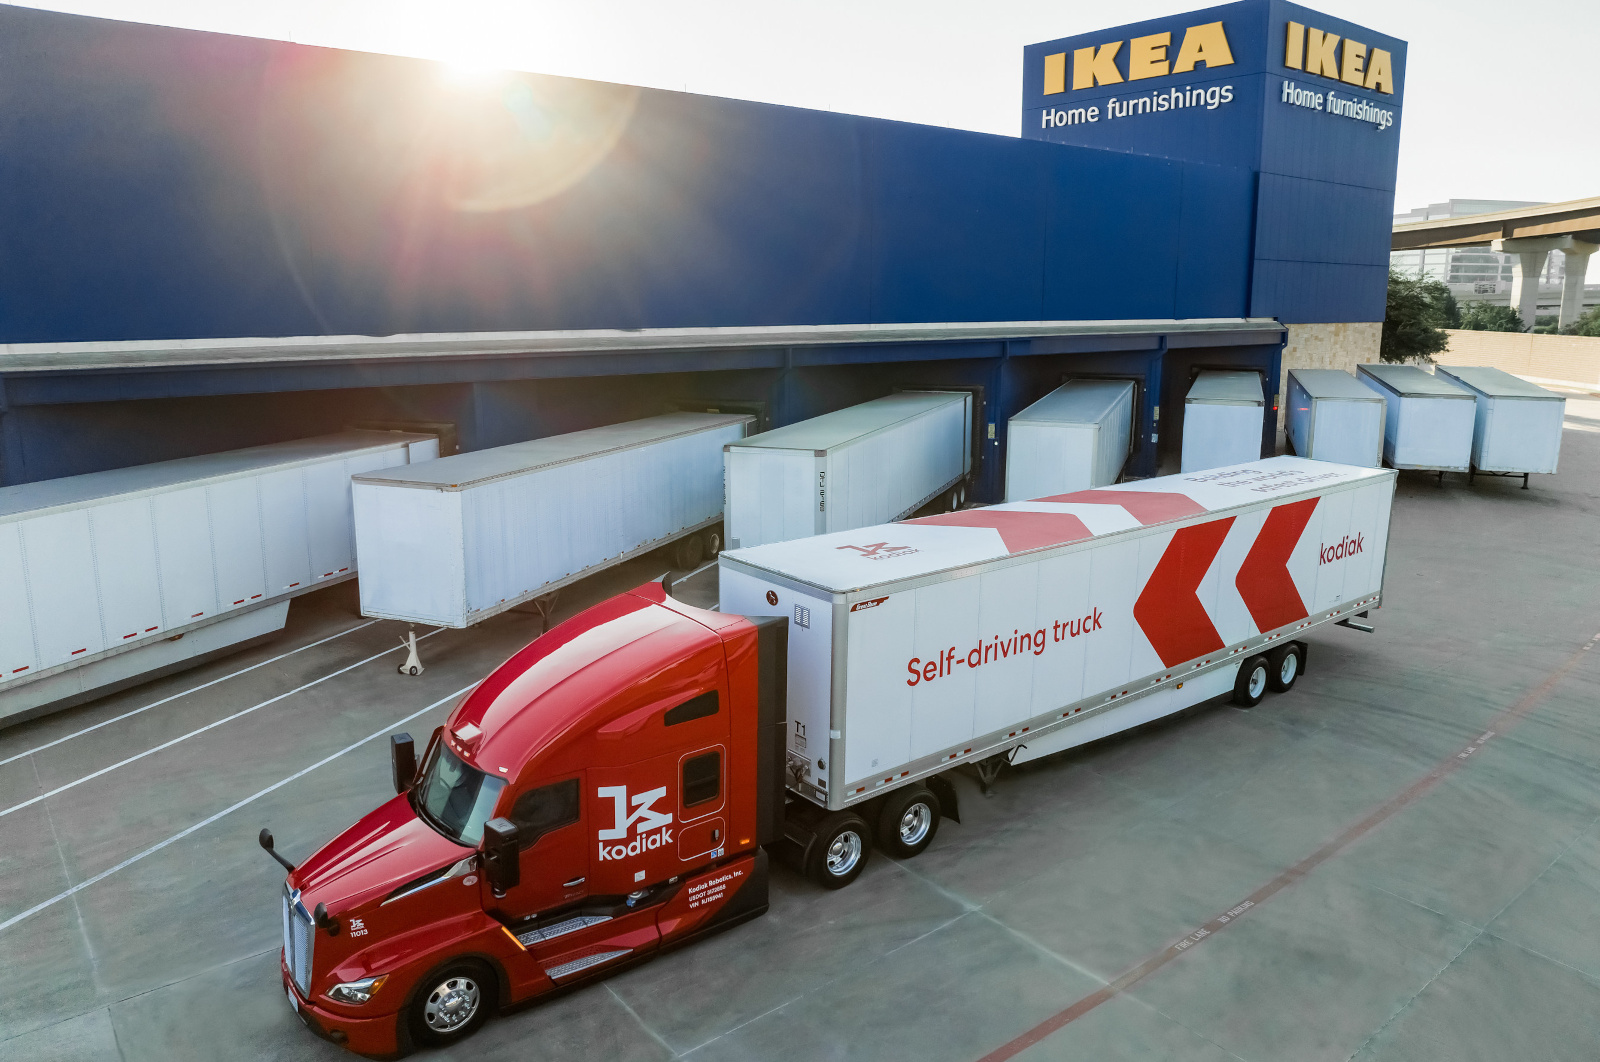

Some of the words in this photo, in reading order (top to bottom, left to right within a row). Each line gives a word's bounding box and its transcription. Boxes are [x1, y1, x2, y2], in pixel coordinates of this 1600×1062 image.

[1043, 21, 1234, 95] IKEA
[1285, 21, 1394, 94] IKEA
[1041, 104, 1100, 128] Home
[1107, 85, 1234, 120] furnishings
[1281, 80, 1324, 110] Home
[1326, 91, 1393, 130] furnishings
[1319, 532, 1365, 566] kodiak
[906, 628, 1046, 687] Self-driving
[1053, 607, 1103, 643] truck
[795, 720, 806, 736] T1
[598, 827, 674, 861] kodiak
[688, 882, 708, 895] Kodiak
[708, 875, 734, 887] Robotics,
[733, 870, 744, 878] Inc.
[688, 891, 707, 902] USDOT
[688, 901, 700, 909] VIN
[350, 929, 368, 938] 11013
[1174, 939, 1194, 951] FIRE
[1190, 928, 1211, 941] LANE
